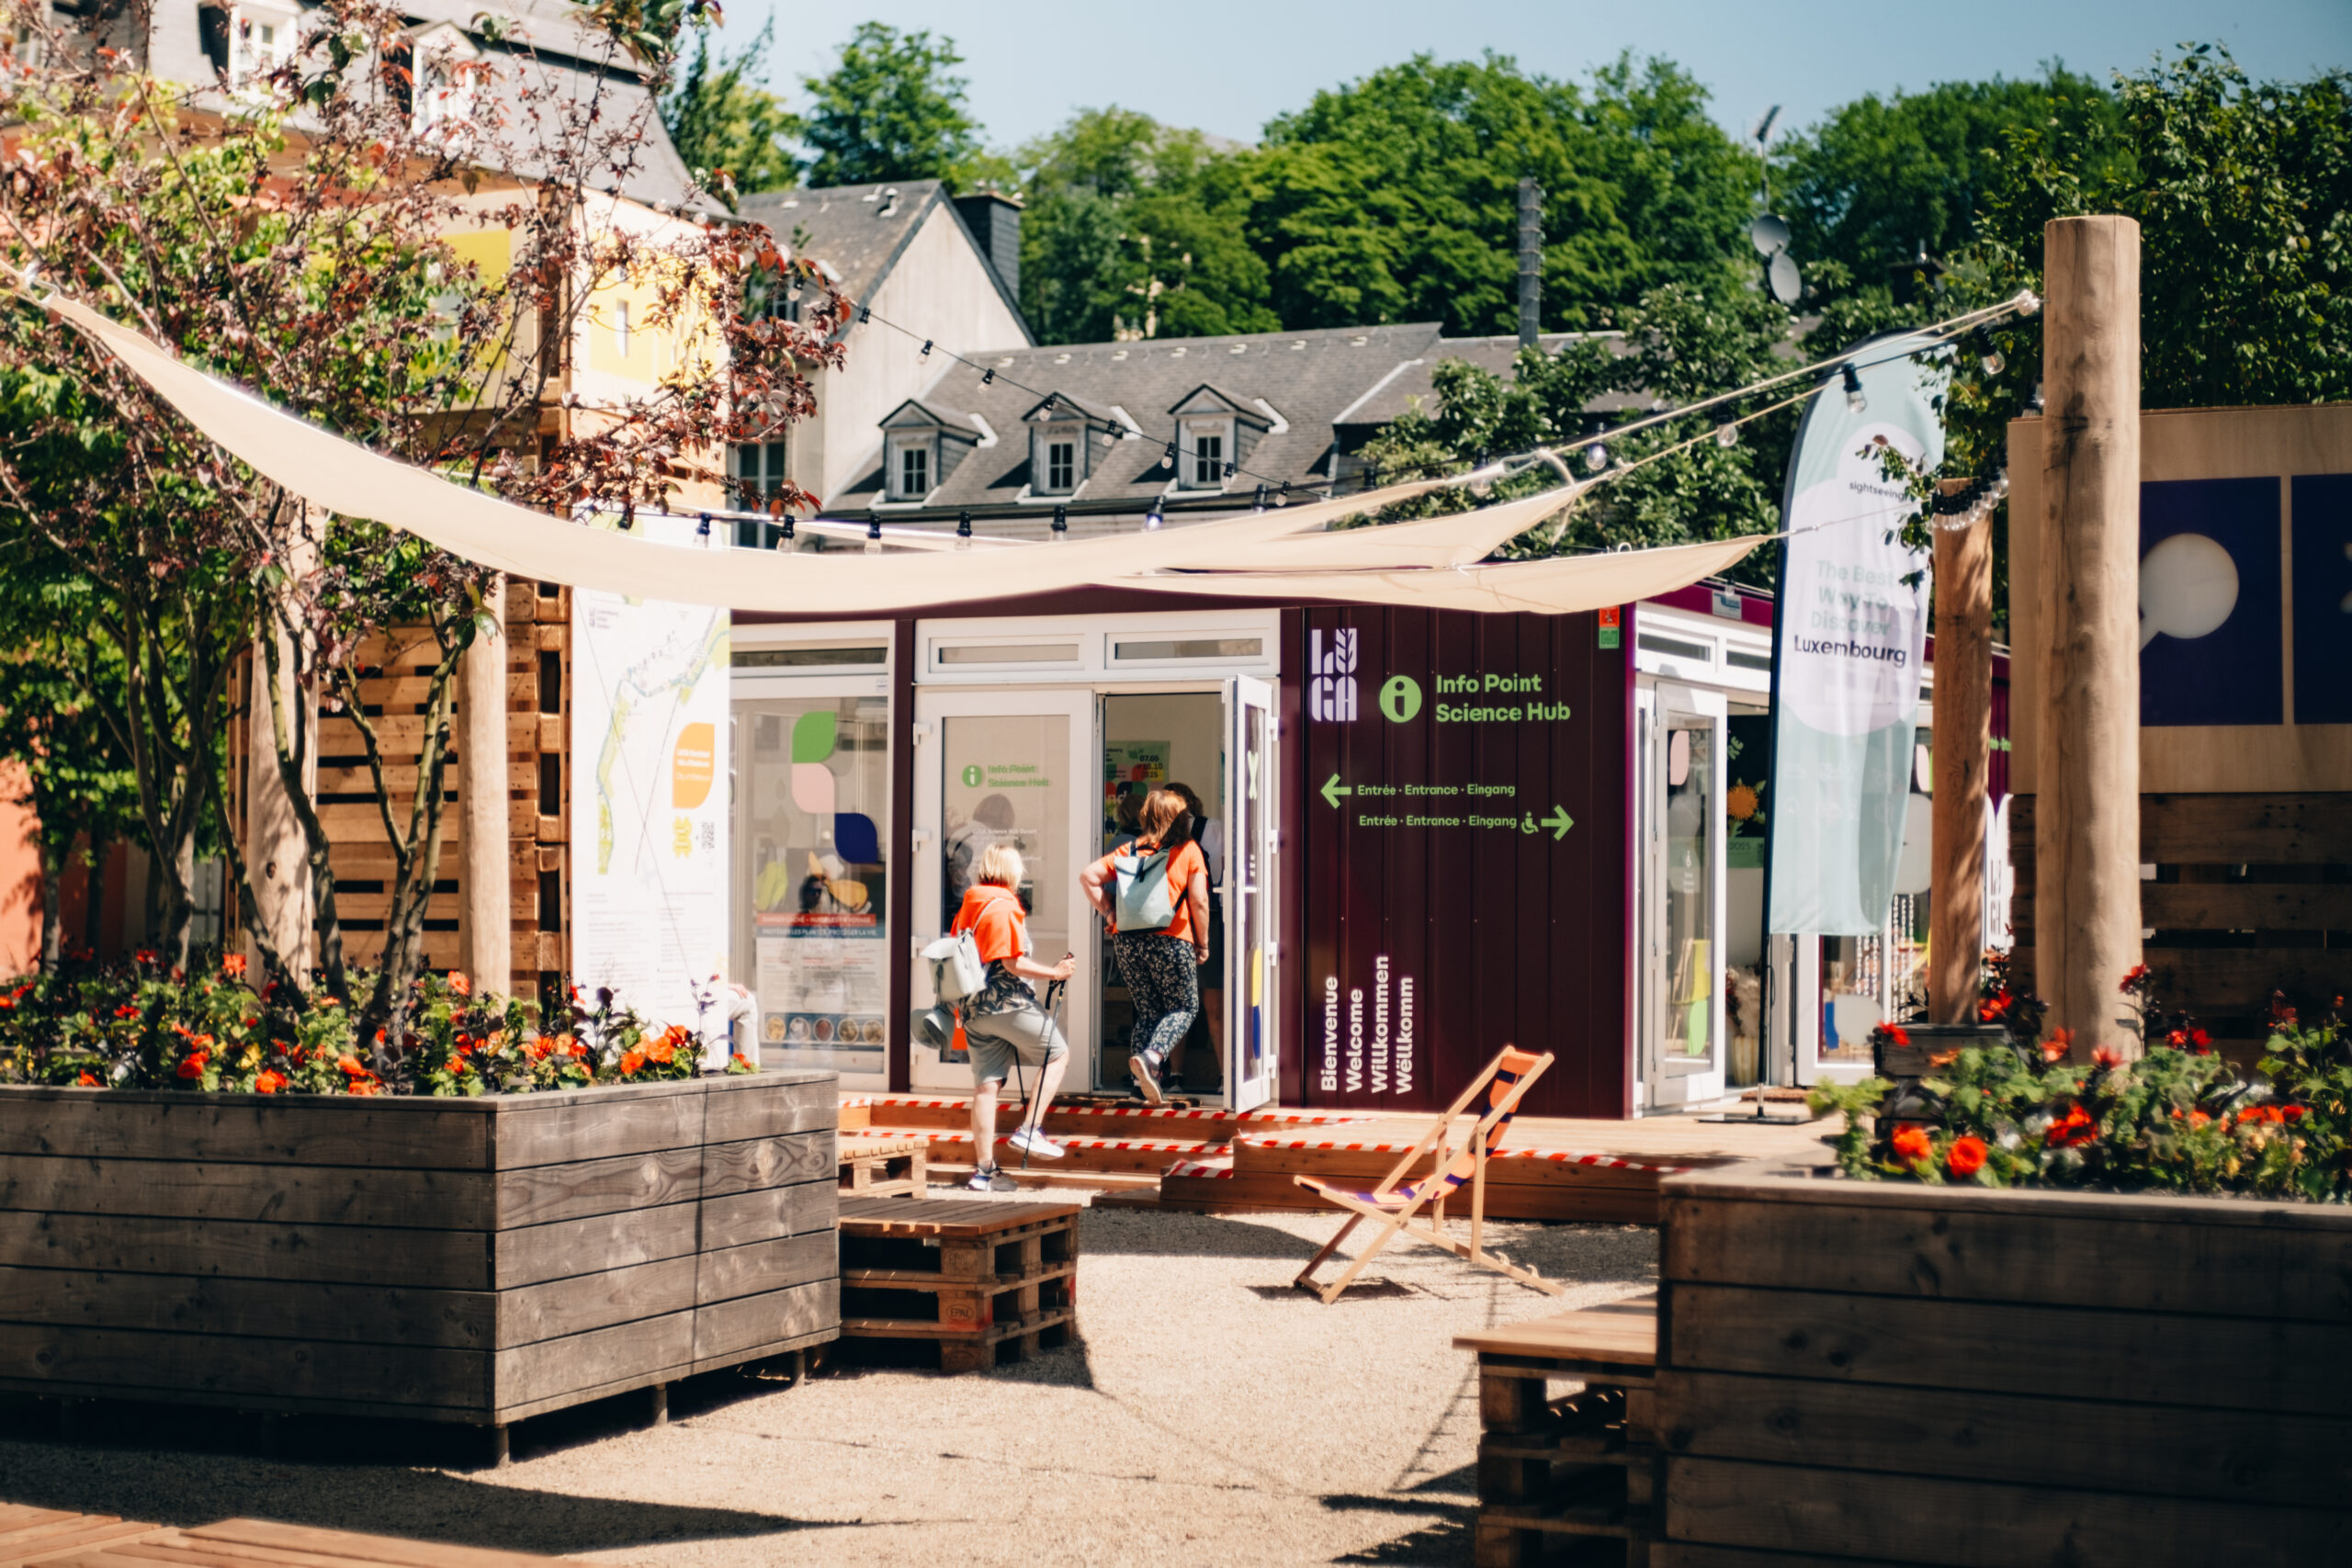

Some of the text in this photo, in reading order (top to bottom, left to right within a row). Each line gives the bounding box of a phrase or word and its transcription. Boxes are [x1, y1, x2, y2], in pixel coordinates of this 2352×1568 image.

[1849, 481, 1905, 502] sightseeing
[1816, 559, 1894, 587] The Best
[1818, 585, 1889, 613] Way To
[1811, 611, 1893, 636] Discover
[1794, 634, 1907, 669] Luxembourg
[1436, 672, 1543, 694] Info Point
[1436, 701, 1571, 722] Science Hub
[1358, 784, 1516, 797] Entrée Entrance Eingang
[1359, 814, 1518, 829] Entrée Entrance Eingang
[1320, 976, 1339, 1091] Bienvenue
[1371, 955, 1389, 1094] Willkommen
[1396, 977, 1414, 1095] Wëllkomm
[1346, 988, 1363, 1093] Welcome
[950, 1307, 970, 1317] EPAL
